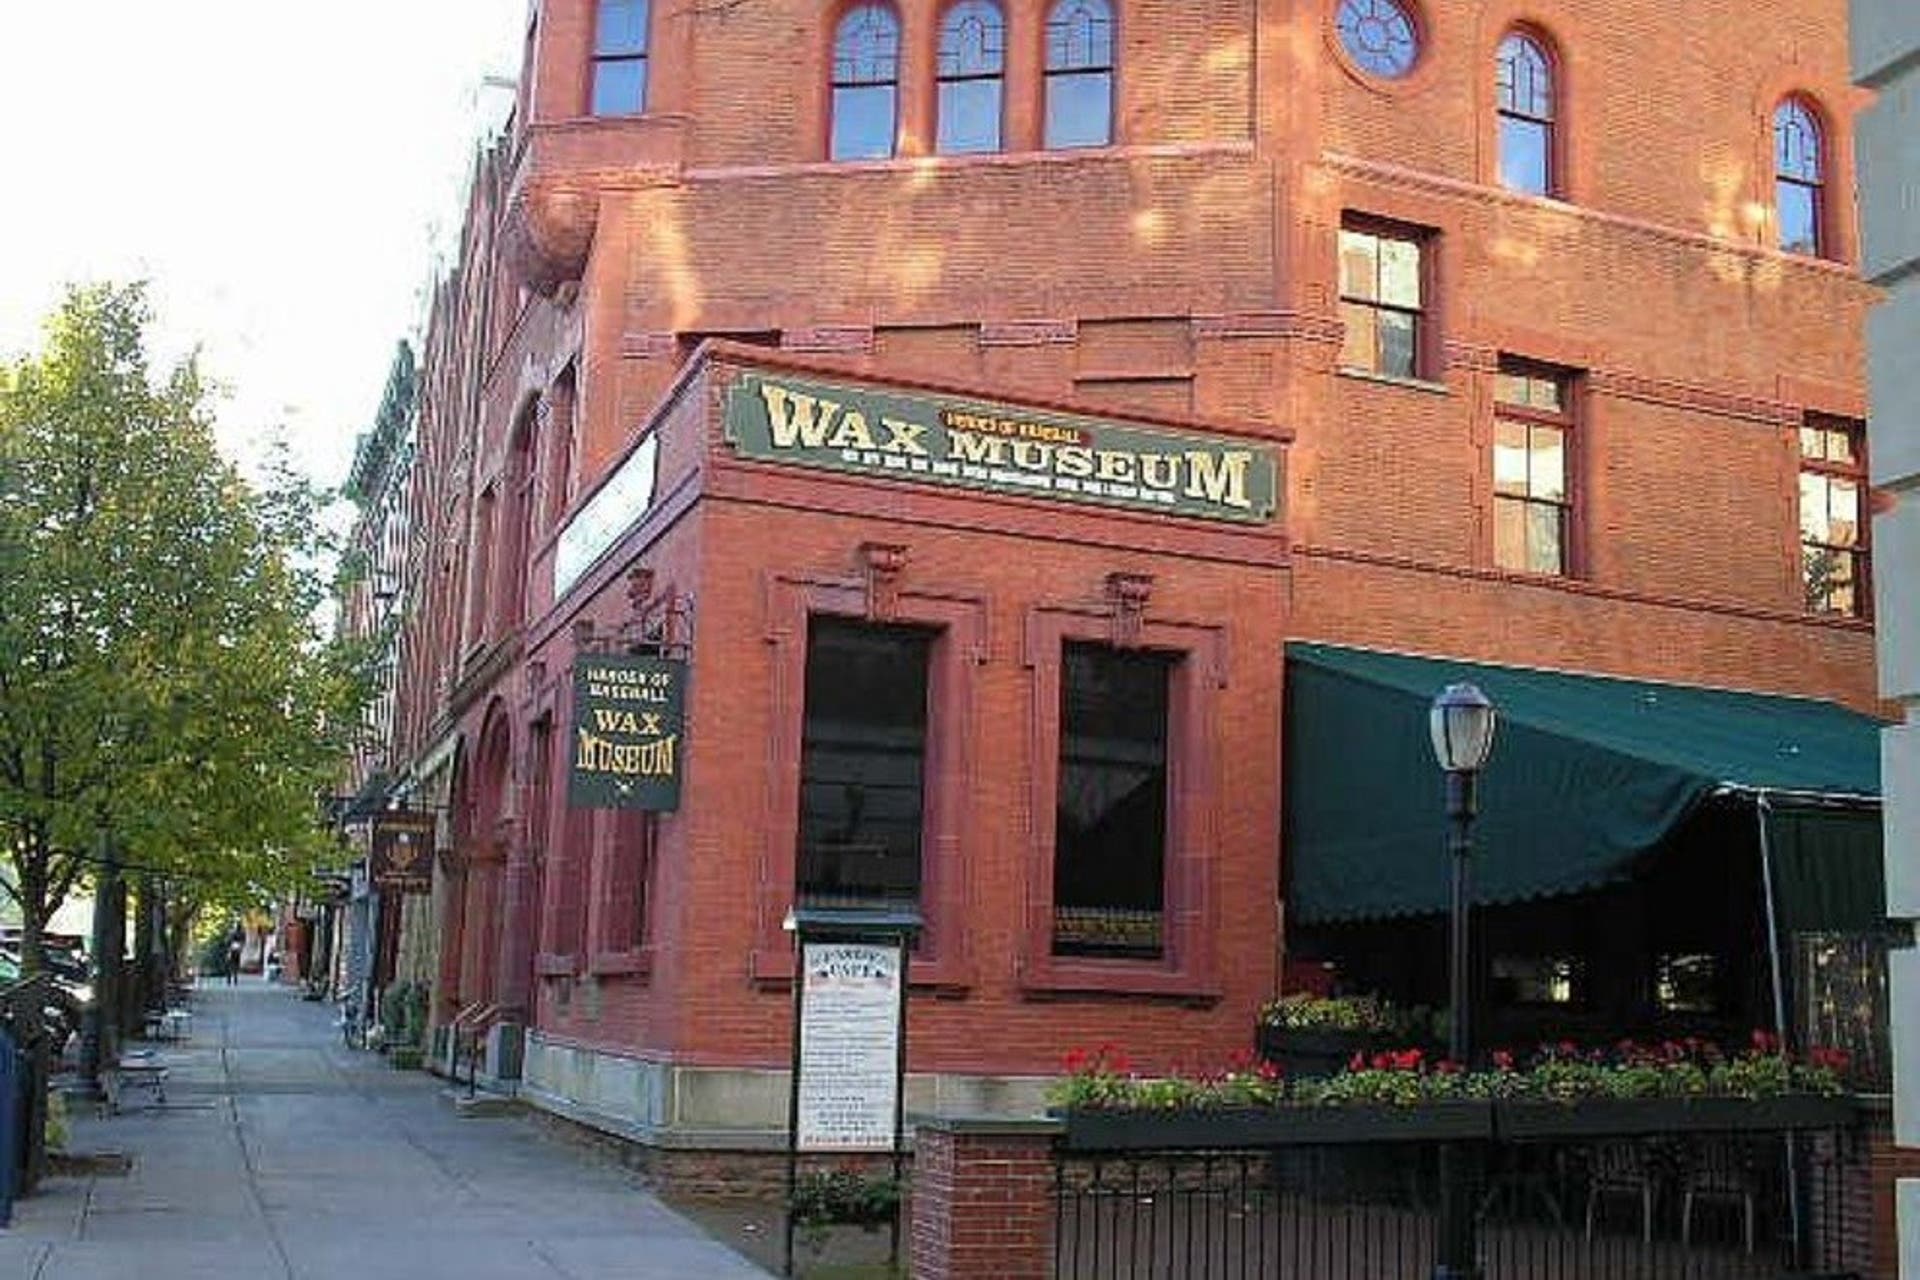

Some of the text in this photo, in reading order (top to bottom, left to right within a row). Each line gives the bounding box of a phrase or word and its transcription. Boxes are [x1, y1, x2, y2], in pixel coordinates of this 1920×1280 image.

[761, 384, 928, 456] WAX
[947, 430, 1251, 507] MUSEUM
[594, 709, 661, 735] WAX
[576, 727, 678, 775] MUSEUM
